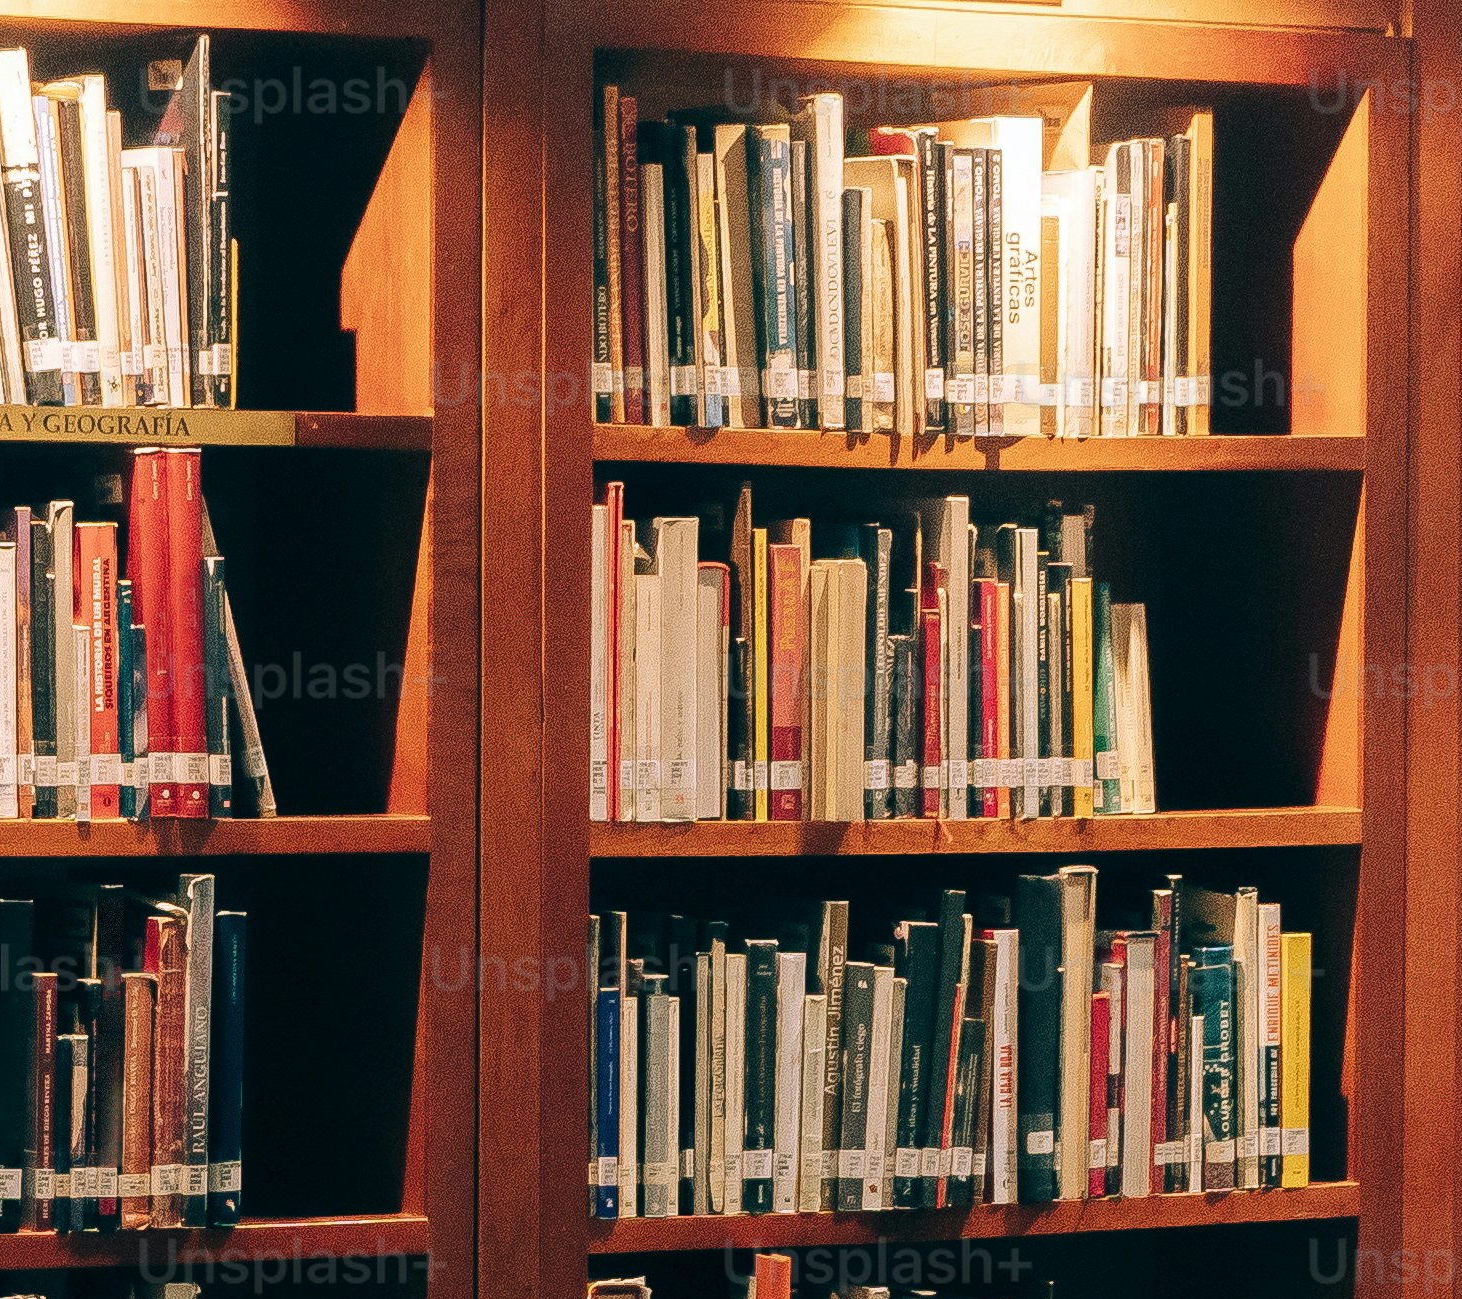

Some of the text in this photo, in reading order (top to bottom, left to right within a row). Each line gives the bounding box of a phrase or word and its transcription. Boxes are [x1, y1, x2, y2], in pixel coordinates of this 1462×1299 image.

[31, 276, 49, 318] HUGO
[1005, 231, 1026, 325] gráficas
[1021, 249, 1039, 309] Artes
[20, 410, 42, 434] Y
[42, 409, 192, 438] GEOGRAFÍA
[92, 557, 104, 712] LA HISTORIA DE UN MURAL
[102, 558, 114, 710] SIQUEIROS EN ARGENTINA
[824, 945, 845, 1096] Agustín Jiménez
[1267, 924, 1279, 1041] ENRIQUE METINIDES
[188, 1005, 208, 1154] RAÚL ANGUIANO
[1220, 999, 1231, 1141] LOURDES GROBET
